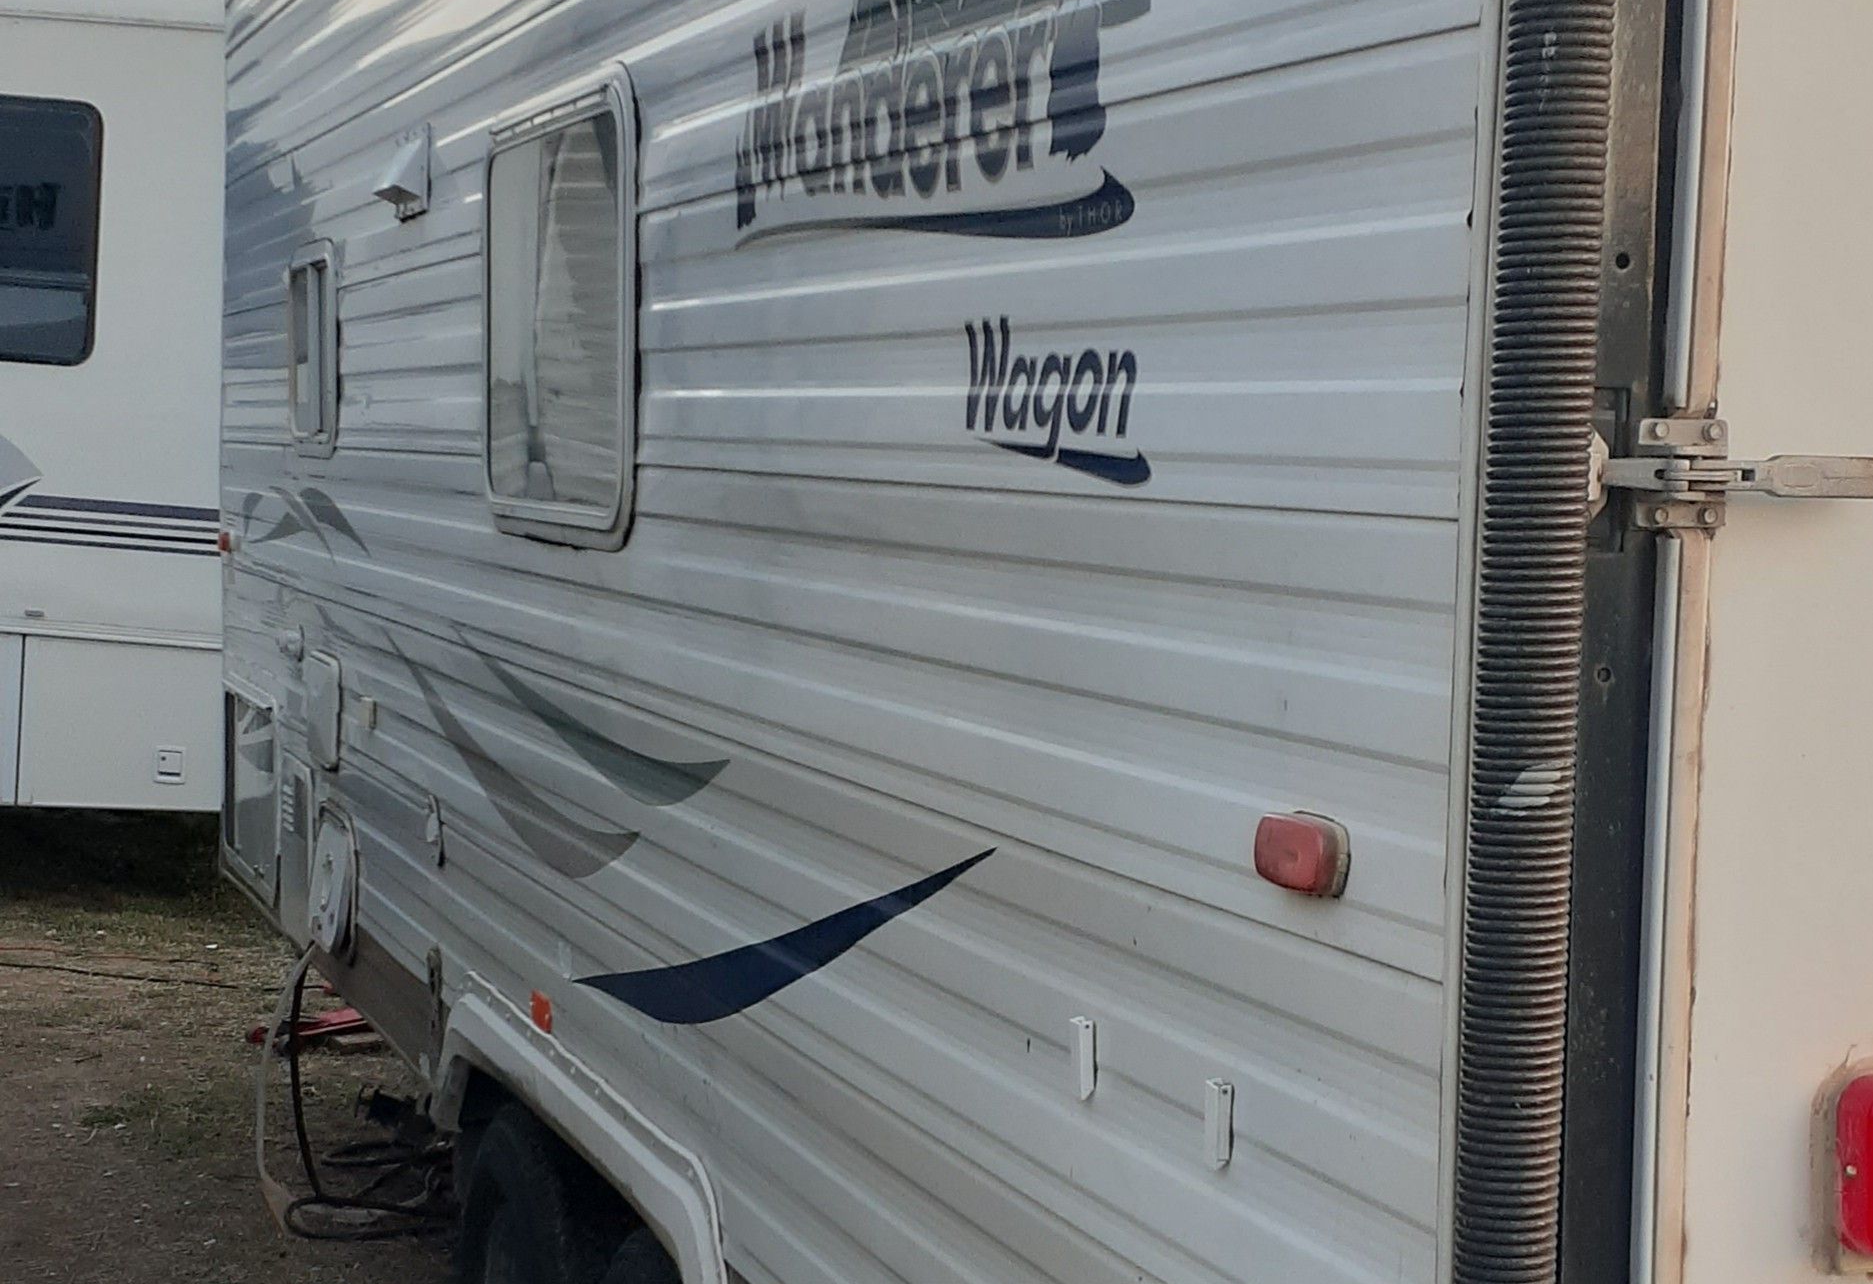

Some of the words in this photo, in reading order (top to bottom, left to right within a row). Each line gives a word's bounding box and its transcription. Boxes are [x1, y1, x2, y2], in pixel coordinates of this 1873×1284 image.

[751, 9, 1052, 202] Wanderer
[1078, 199, 1124, 228] THOR
[965, 316, 1138, 460] Wagon
